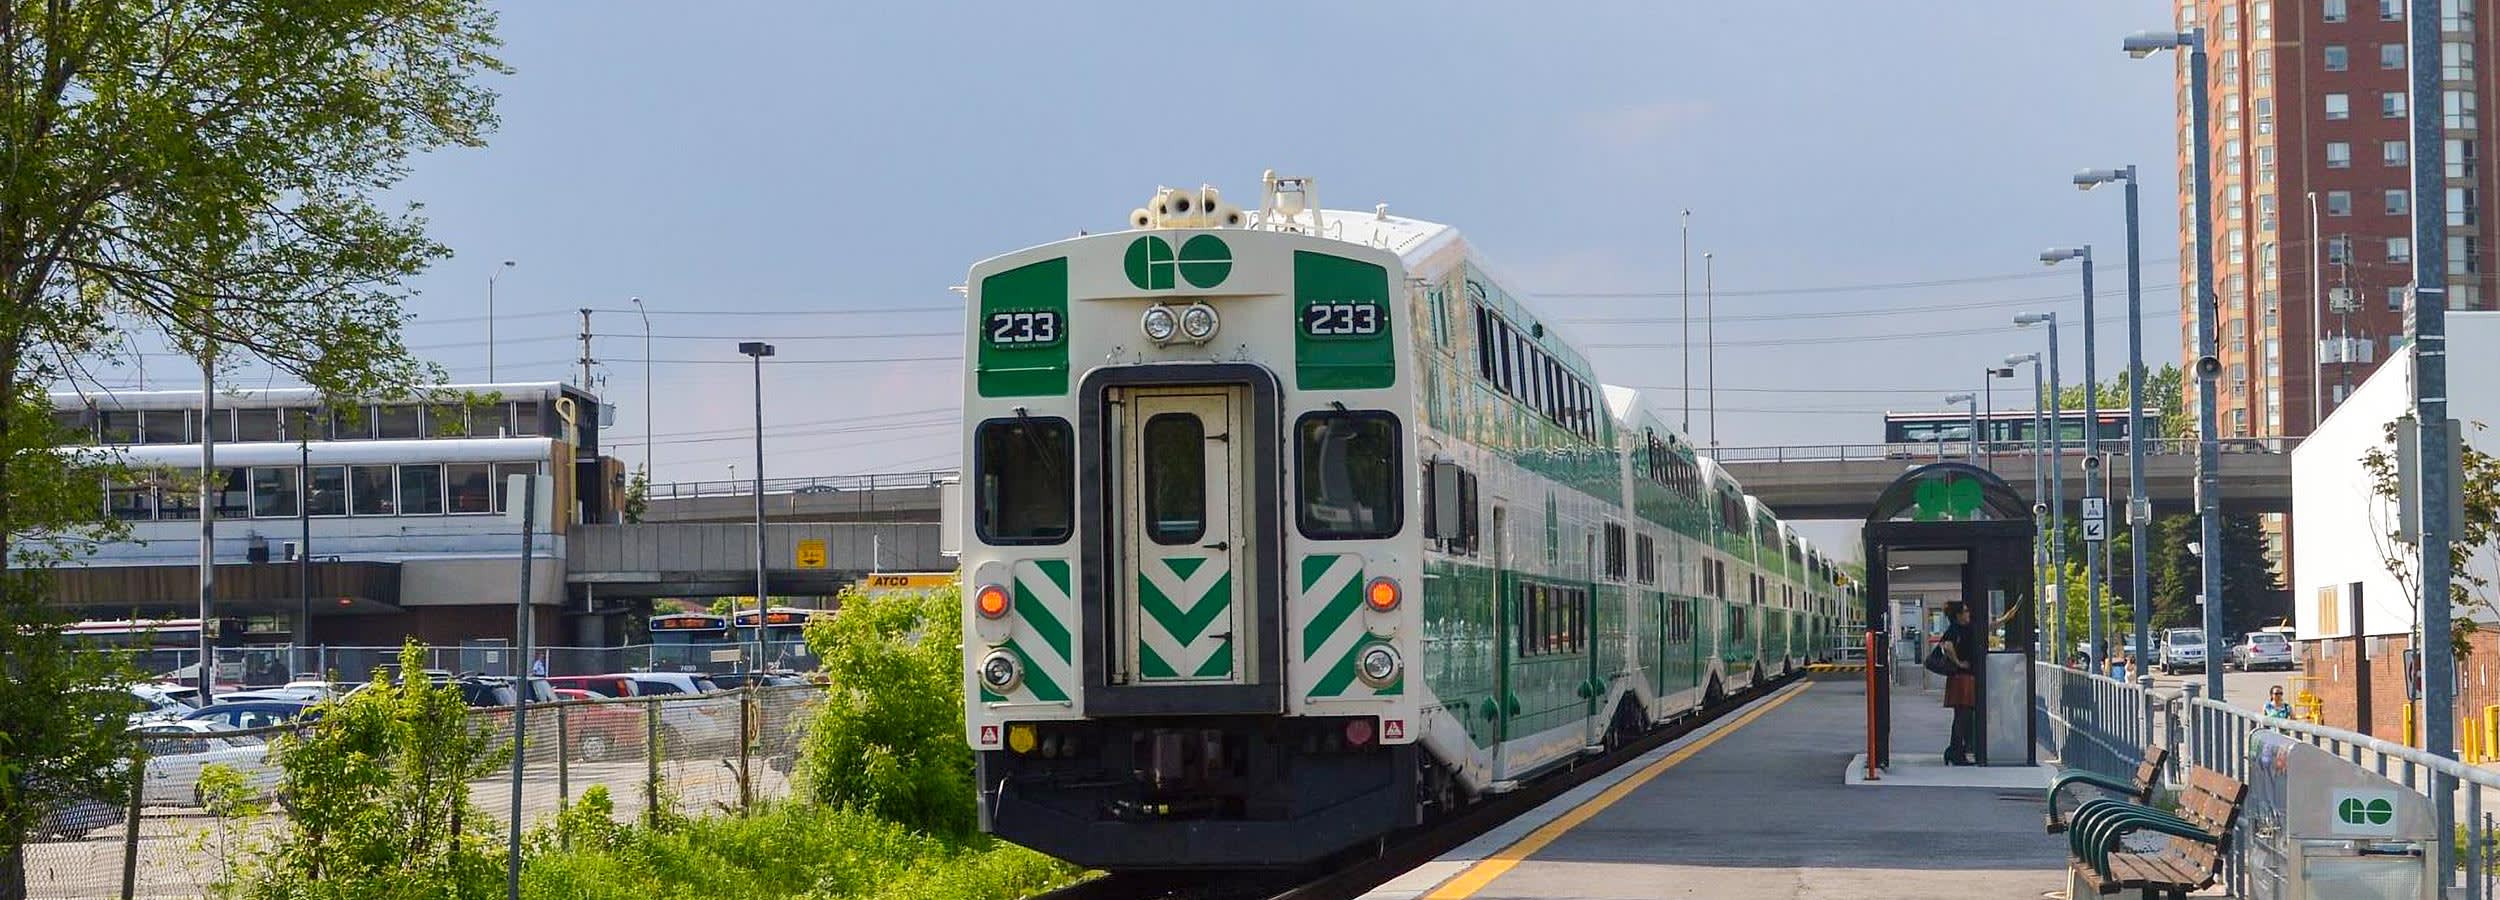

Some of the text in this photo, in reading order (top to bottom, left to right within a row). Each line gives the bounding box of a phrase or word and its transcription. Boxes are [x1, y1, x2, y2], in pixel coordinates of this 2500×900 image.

[1124, 234, 1232, 289] GO
[994, 313, 1053, 342] 233
[1311, 305, 1375, 334] 233
[874, 576, 909, 586] ATCO
[2339, 798, 2392, 825] GO
